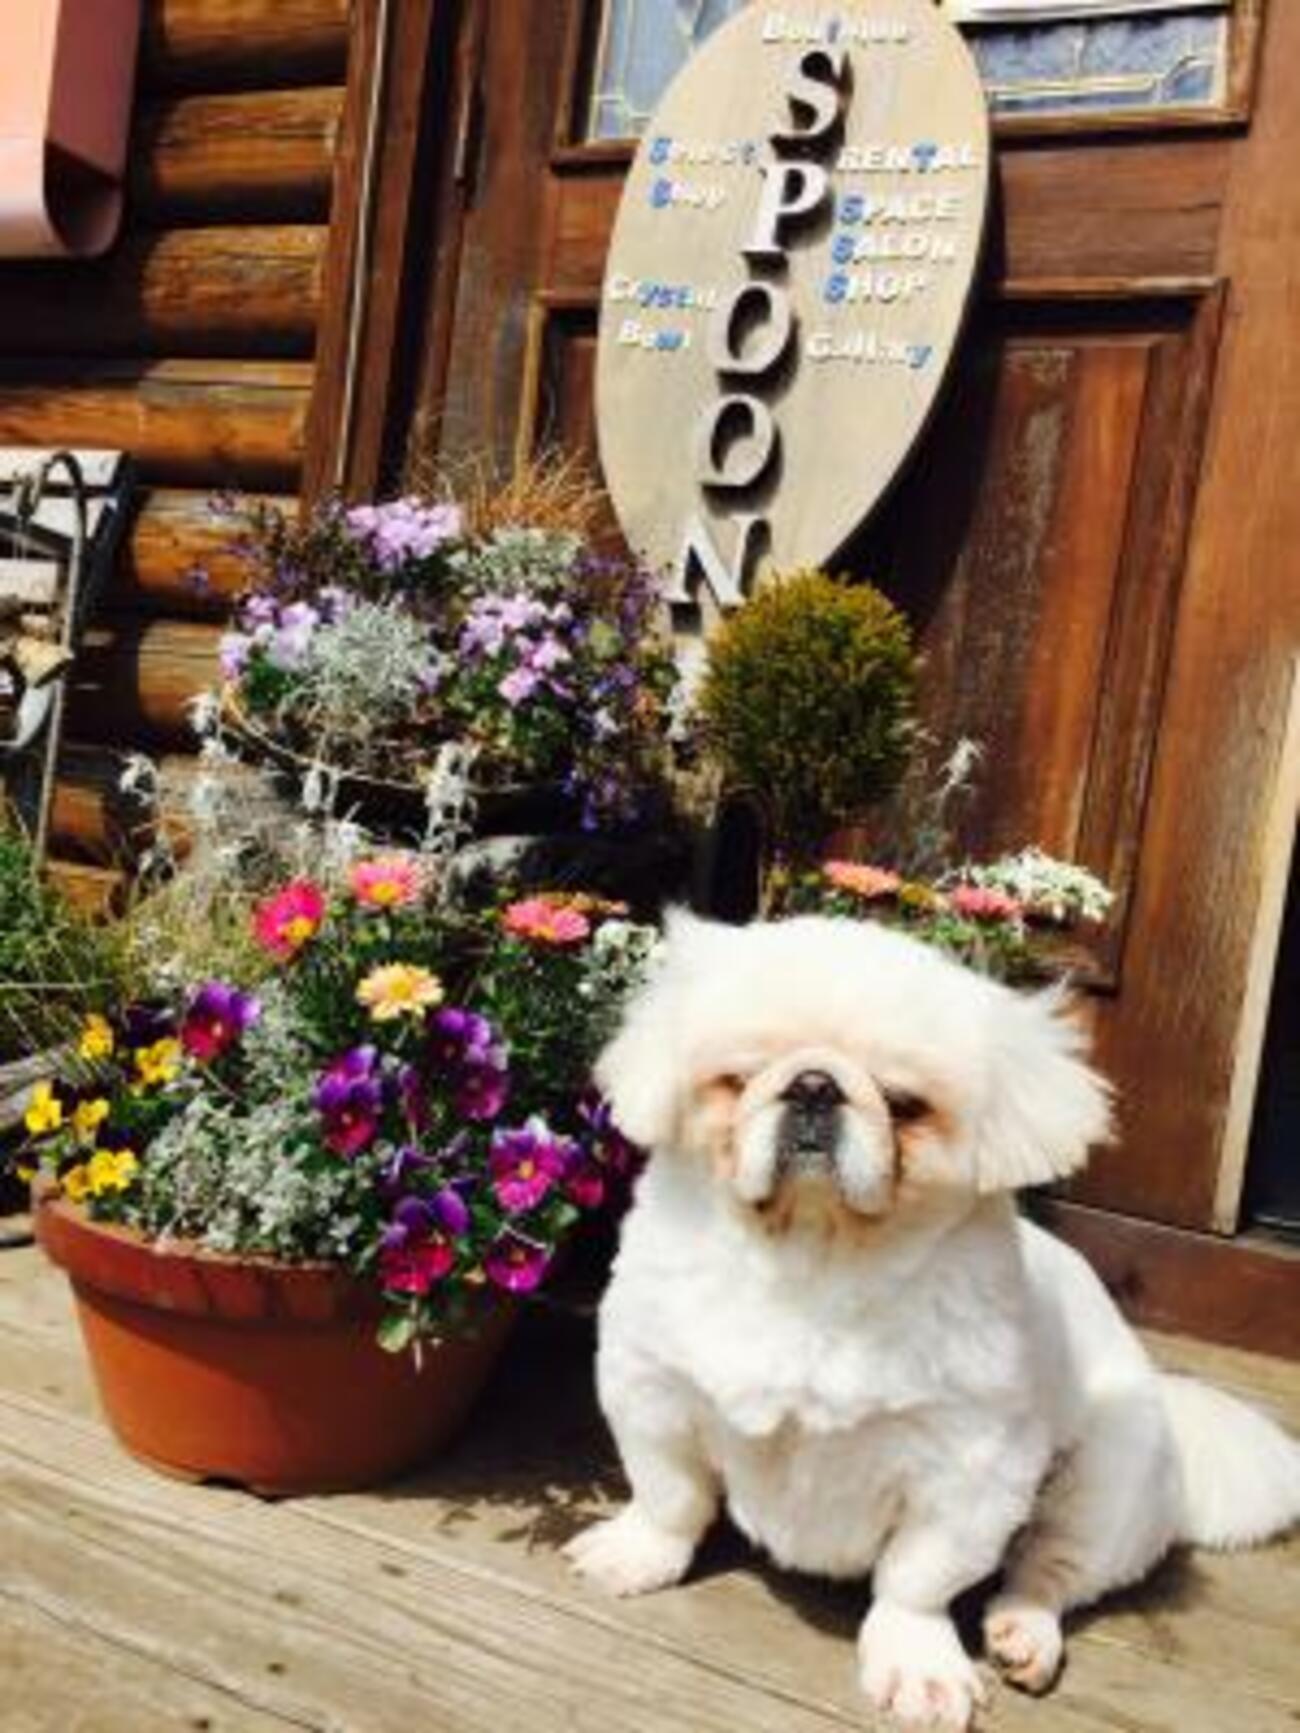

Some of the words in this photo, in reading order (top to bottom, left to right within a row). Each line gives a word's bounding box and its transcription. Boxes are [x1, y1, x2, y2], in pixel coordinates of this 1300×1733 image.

[837, 139, 976, 172] RENTAL
[838, 193, 961, 226] SPACE
[831, 232, 955, 266] SALON
[824, 270, 927, 303] SHOP
[664, 48, 848, 607] SPOON
